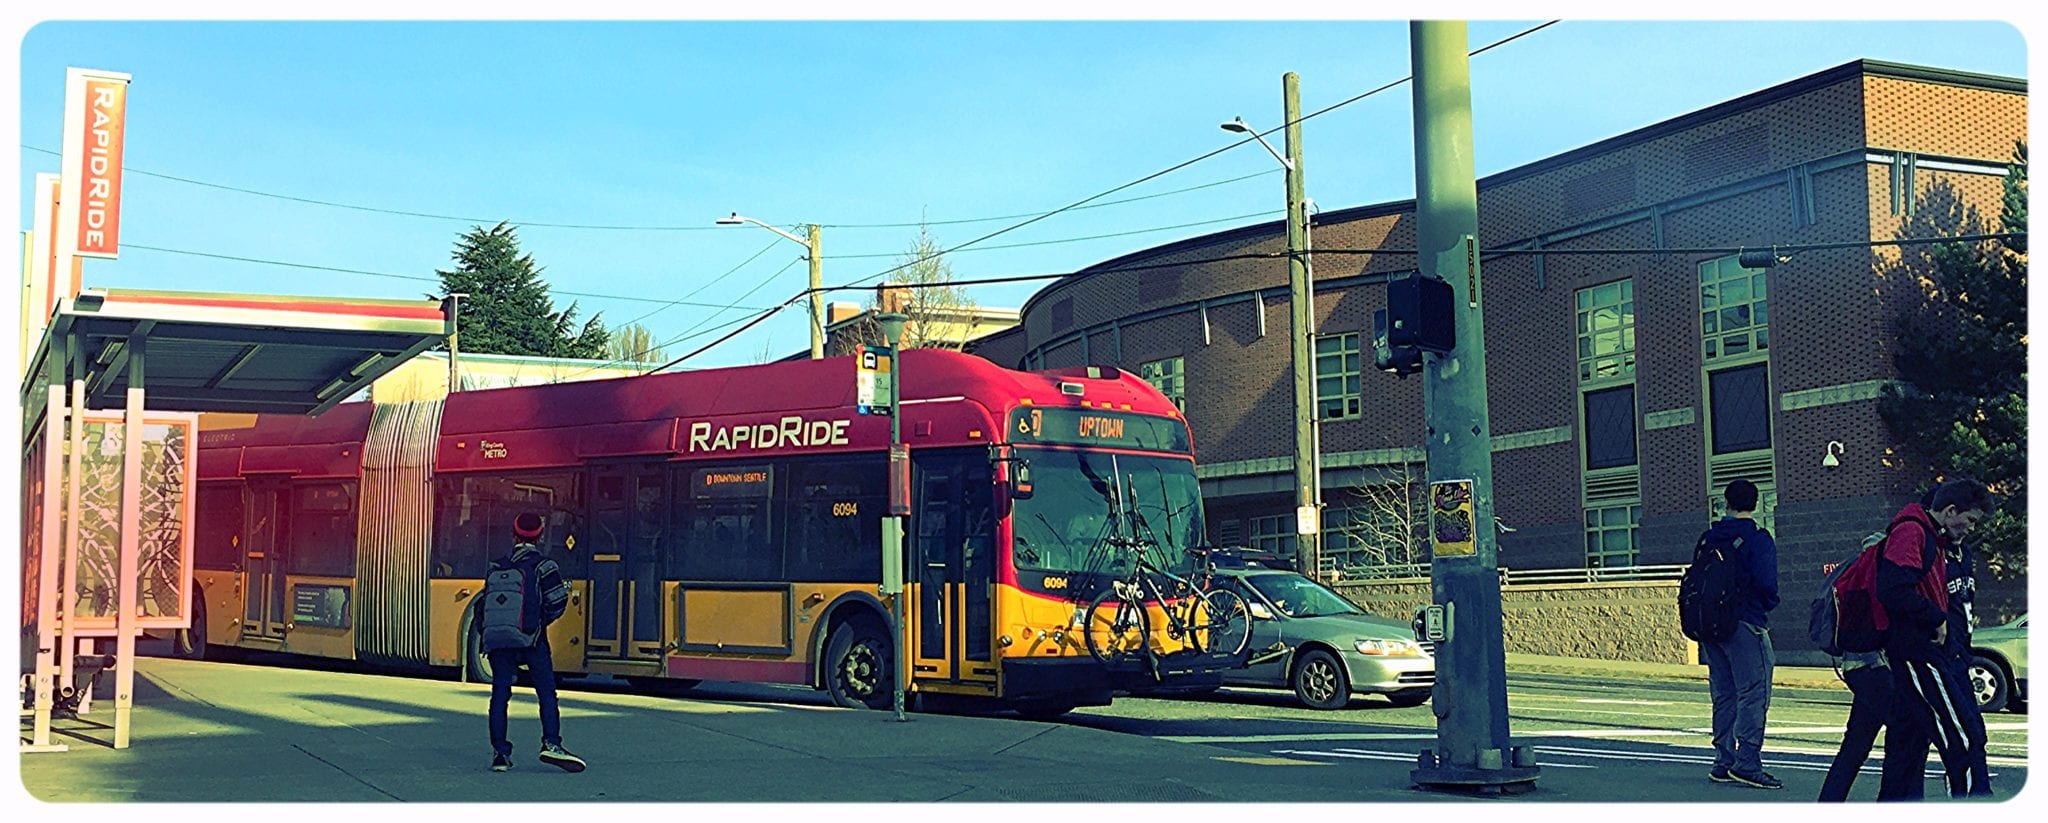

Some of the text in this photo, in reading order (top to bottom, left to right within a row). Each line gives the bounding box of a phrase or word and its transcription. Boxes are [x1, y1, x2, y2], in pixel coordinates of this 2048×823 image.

[1079, 416, 1124, 439] UPTOWN
[689, 416, 850, 453] RAPIDRIDE
[484, 449, 507, 459] METRO
[713, 473, 742, 484] DOWNTOWN
[743, 472, 767, 483] SEATTLE
[832, 502, 858, 516] 6094
[1043, 576, 1068, 589] 6094
